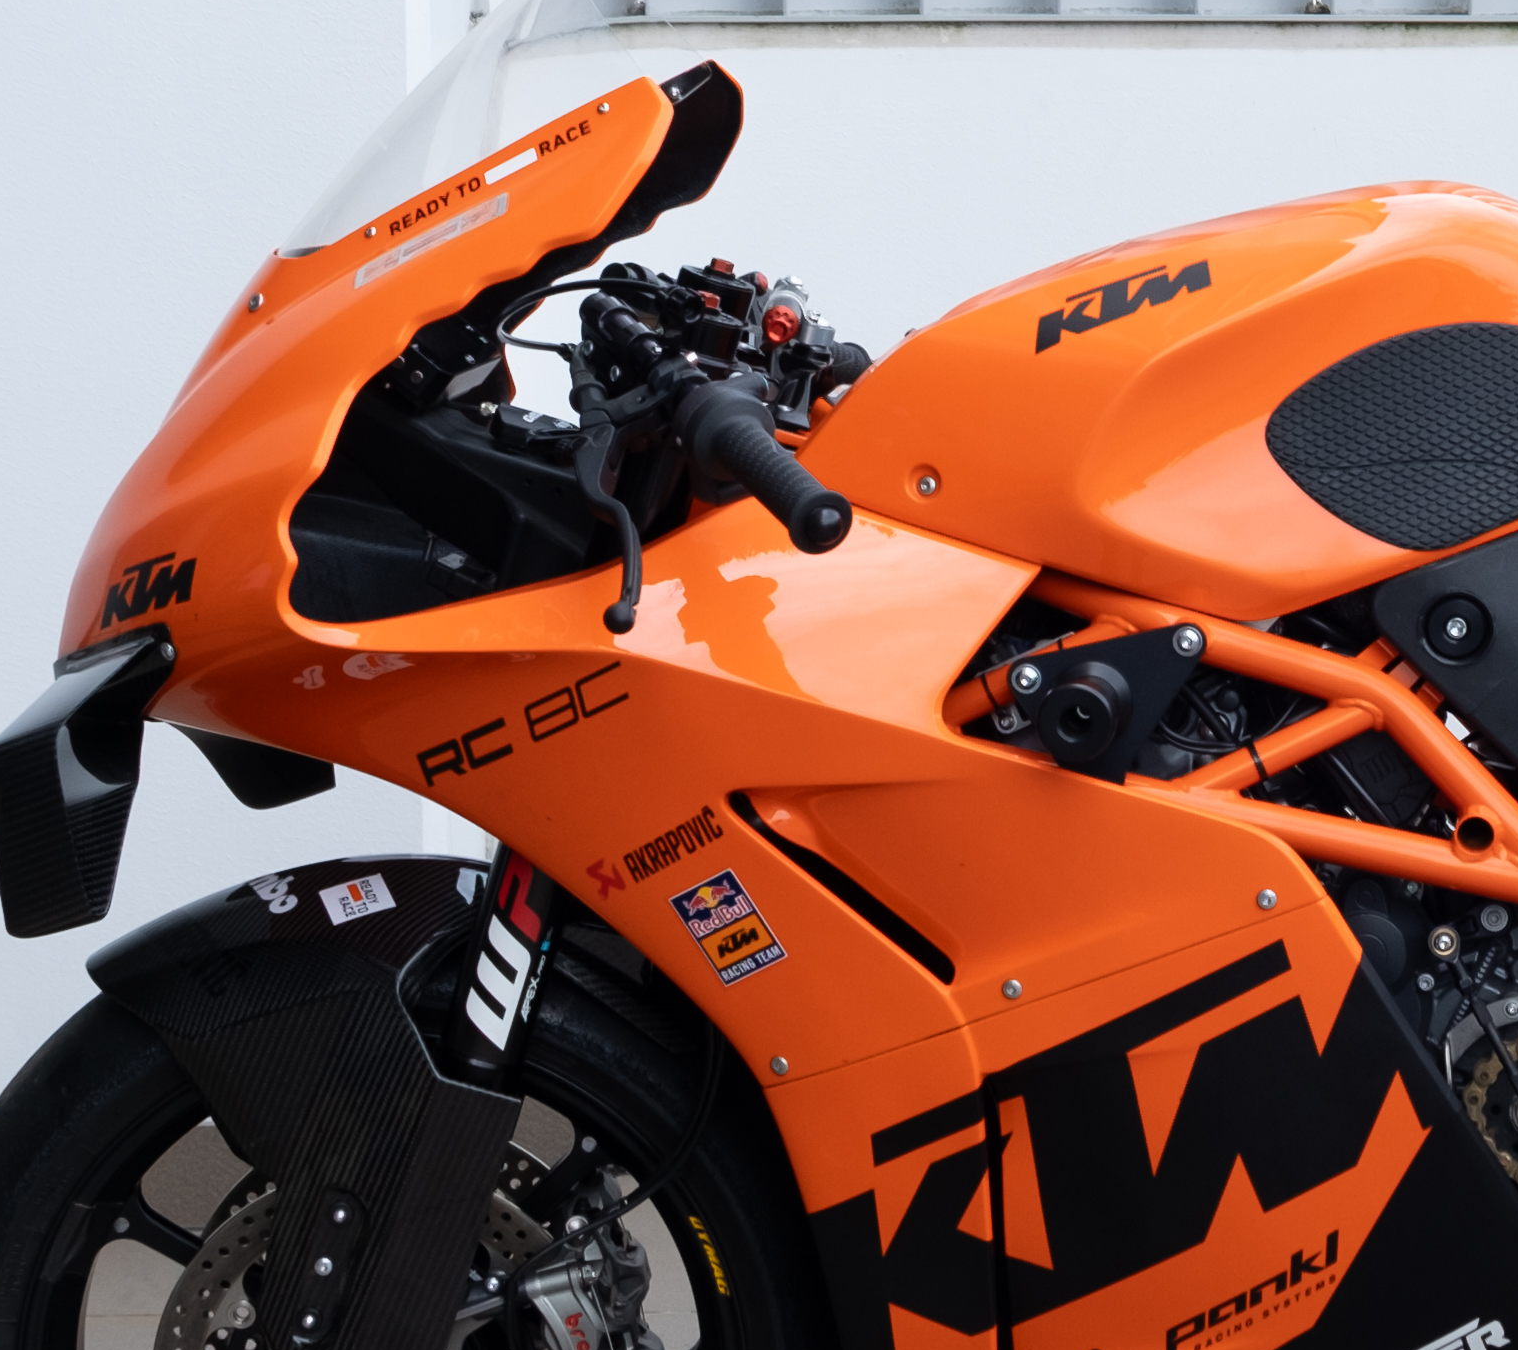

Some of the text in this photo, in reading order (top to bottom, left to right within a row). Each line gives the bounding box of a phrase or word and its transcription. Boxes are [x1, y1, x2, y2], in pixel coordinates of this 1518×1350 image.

[389, 192, 450, 236] READY
[456, 177, 481, 198] TO
[538, 120, 592, 155] RACE
[1035, 259, 1212, 355] KTM
[100, 552, 197, 630] KTM
[416, 661, 629, 787] RC 8C
[337, 896, 357, 918] RACE
[358, 879, 379, 905] READY
[717, 927, 760, 959] KTM
[721, 945, 782, 982] RACING TEAM
[688, 1215, 730, 1296] DYMAG
[1261, 1274, 1338, 1322] SYSTEMS
